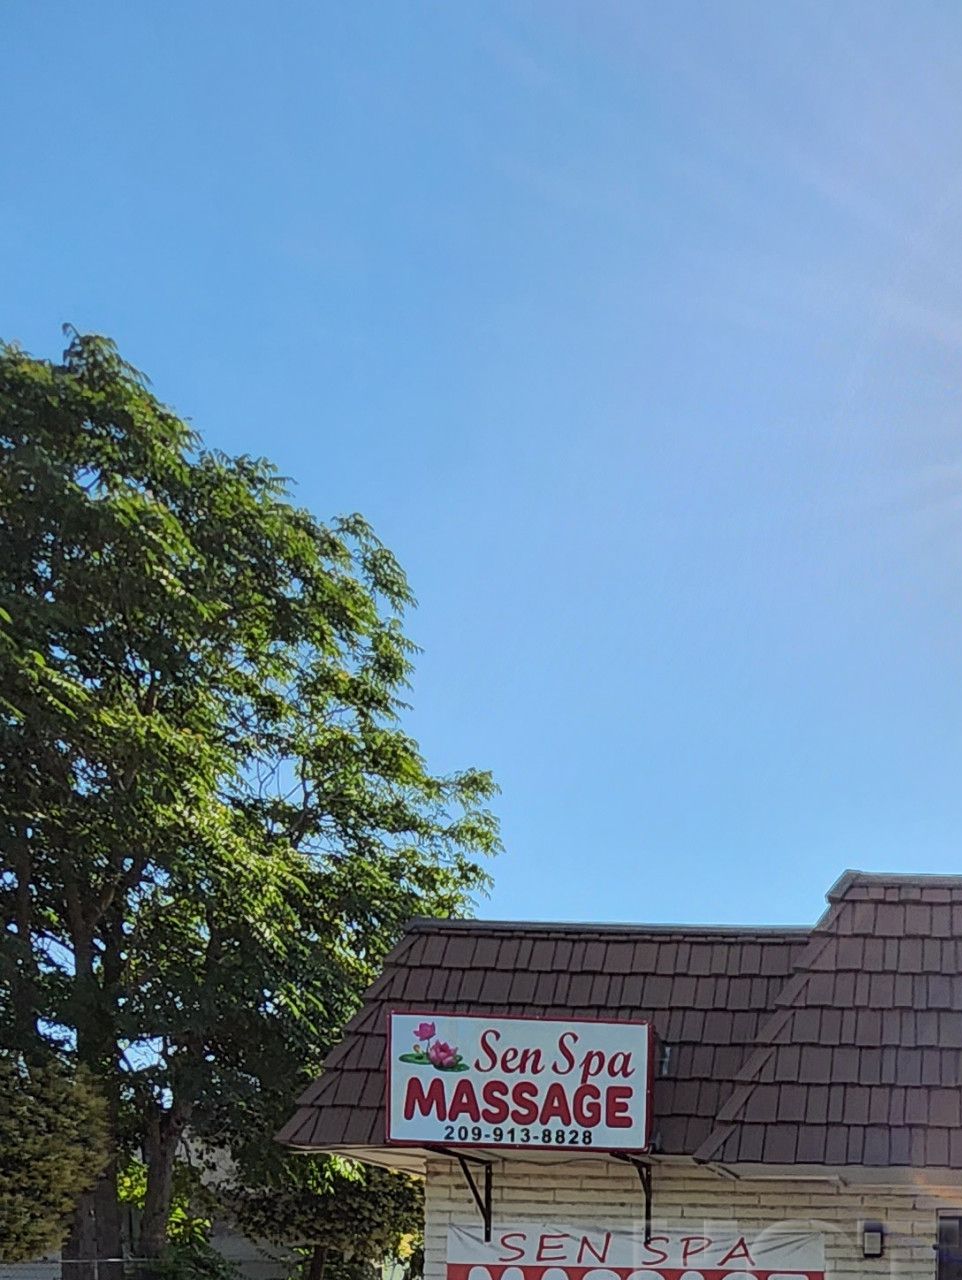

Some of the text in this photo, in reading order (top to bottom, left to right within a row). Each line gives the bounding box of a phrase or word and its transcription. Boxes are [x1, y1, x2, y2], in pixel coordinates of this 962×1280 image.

[474, 1029, 636, 1083] Sen Spa
[404, 1077, 634, 1128] MASSAGE
[444, 1126, 593, 1145] 209-913-8828
[499, 1231, 756, 1267] SEN SPA
